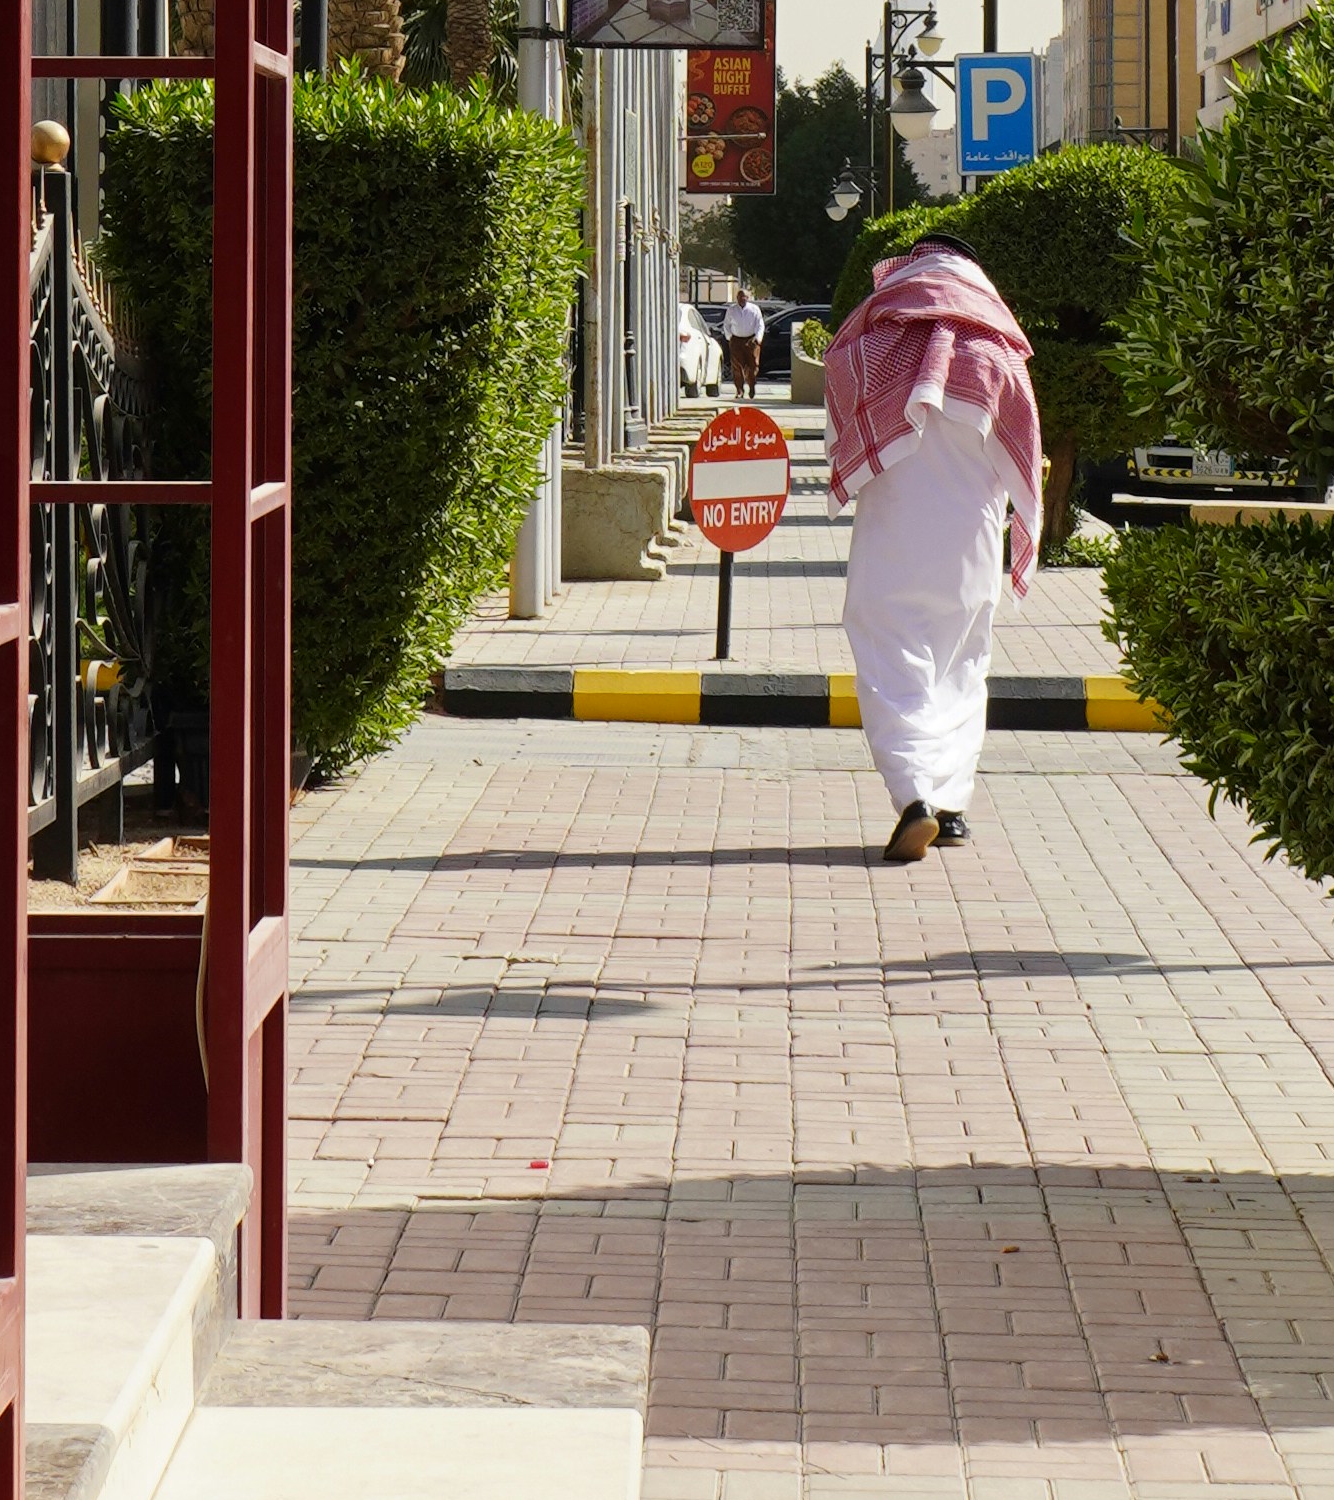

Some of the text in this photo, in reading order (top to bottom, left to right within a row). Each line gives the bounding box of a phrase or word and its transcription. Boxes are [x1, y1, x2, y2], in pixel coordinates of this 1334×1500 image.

[714, 57, 751, 71] ASIAN
[713, 70, 751, 85] NIGHT
[713, 84, 751, 96] BUFFET
[970, 67, 1027, 142] P
[965, 149, 1031, 163] مواقف عامة
[702, 426, 777, 452] ممنوع الدخول
[703, 500, 779, 528] NO ENTRY
